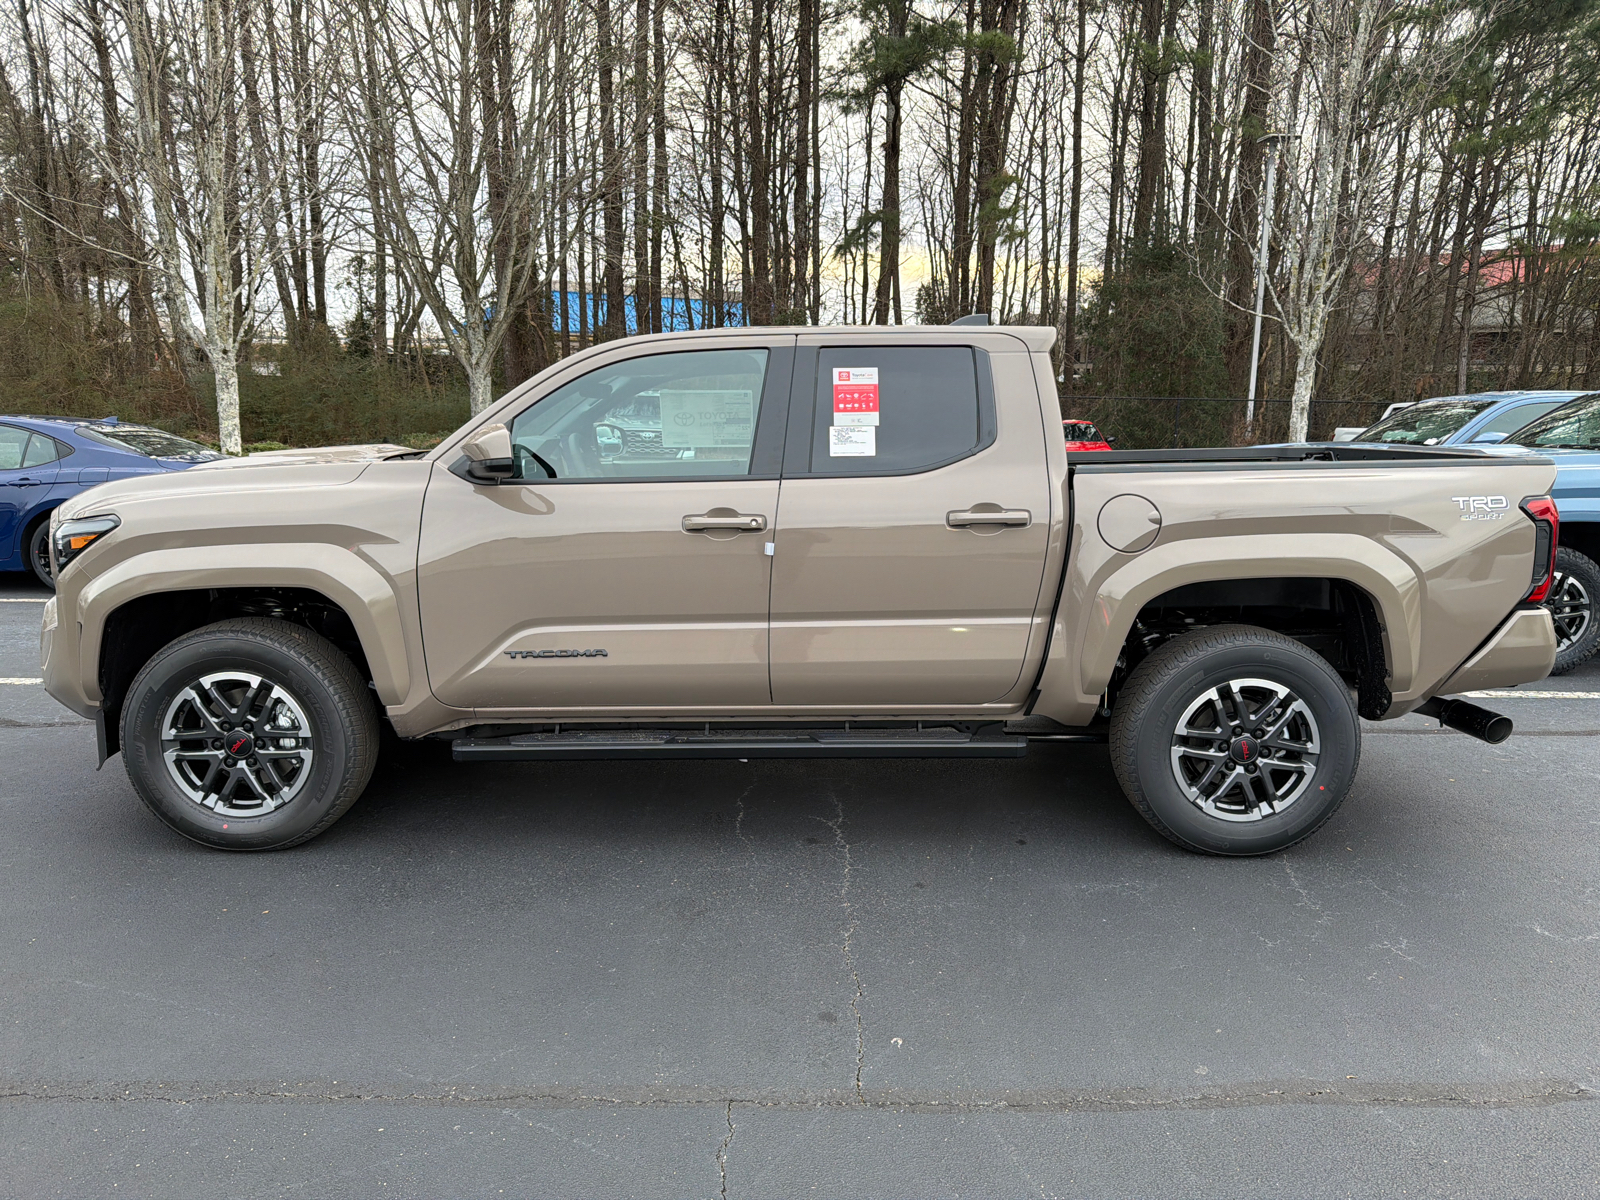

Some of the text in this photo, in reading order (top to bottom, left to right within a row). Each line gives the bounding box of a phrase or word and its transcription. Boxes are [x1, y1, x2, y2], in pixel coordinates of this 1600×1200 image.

[697, 411, 740, 420] TOYOTA
[1451, 495, 1509, 513] TRD
[1460, 512, 1505, 521] SPORT
[503, 648, 609, 660] TACOMA
